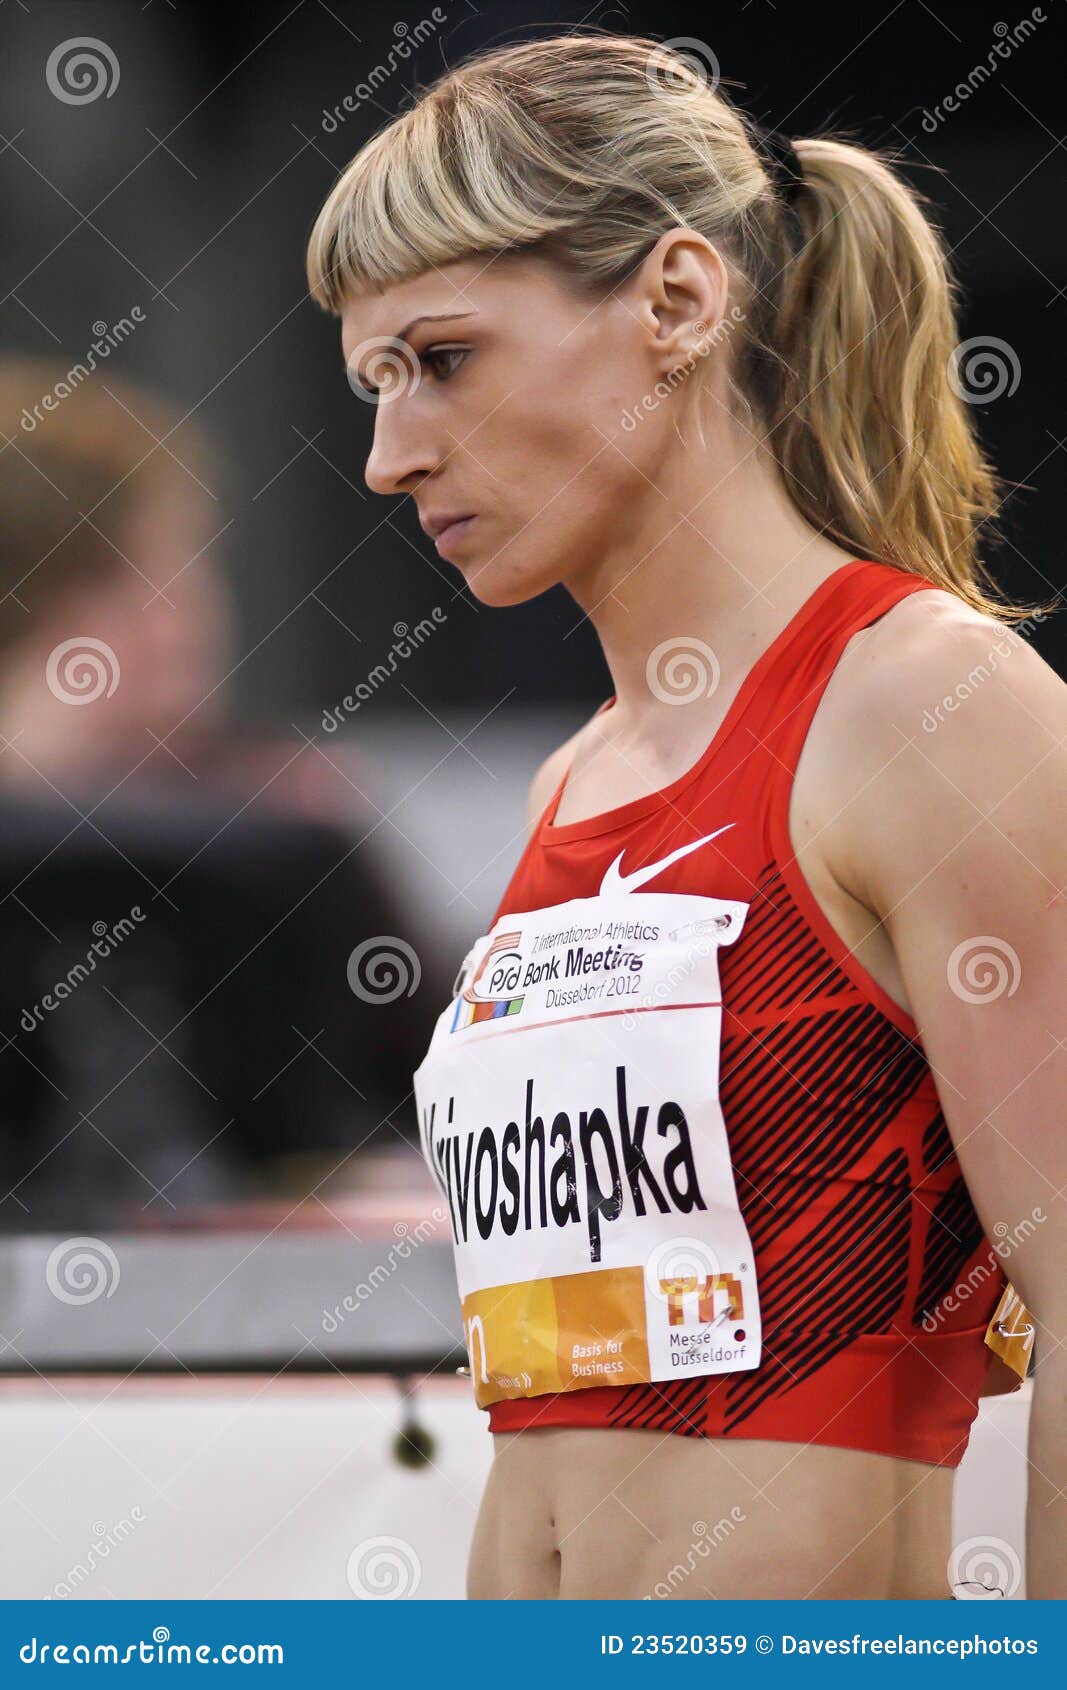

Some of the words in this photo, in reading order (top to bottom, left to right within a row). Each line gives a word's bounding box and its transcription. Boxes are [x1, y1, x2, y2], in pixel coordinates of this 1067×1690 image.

[539, 922, 603, 951] International
[606, 920, 660, 941] Athletics
[523, 955, 560, 988] Bank
[546, 980, 606, 1008] Düsseldorf
[607, 974, 641, 996] 2012
[572, 1344, 601, 1359] Basis
[607, 1340, 623, 1354] for
[670, 1332, 711, 1347] Messe
[672, 1346, 747, 1367] Düsseldorf
[572, 1361, 624, 1377] Business
